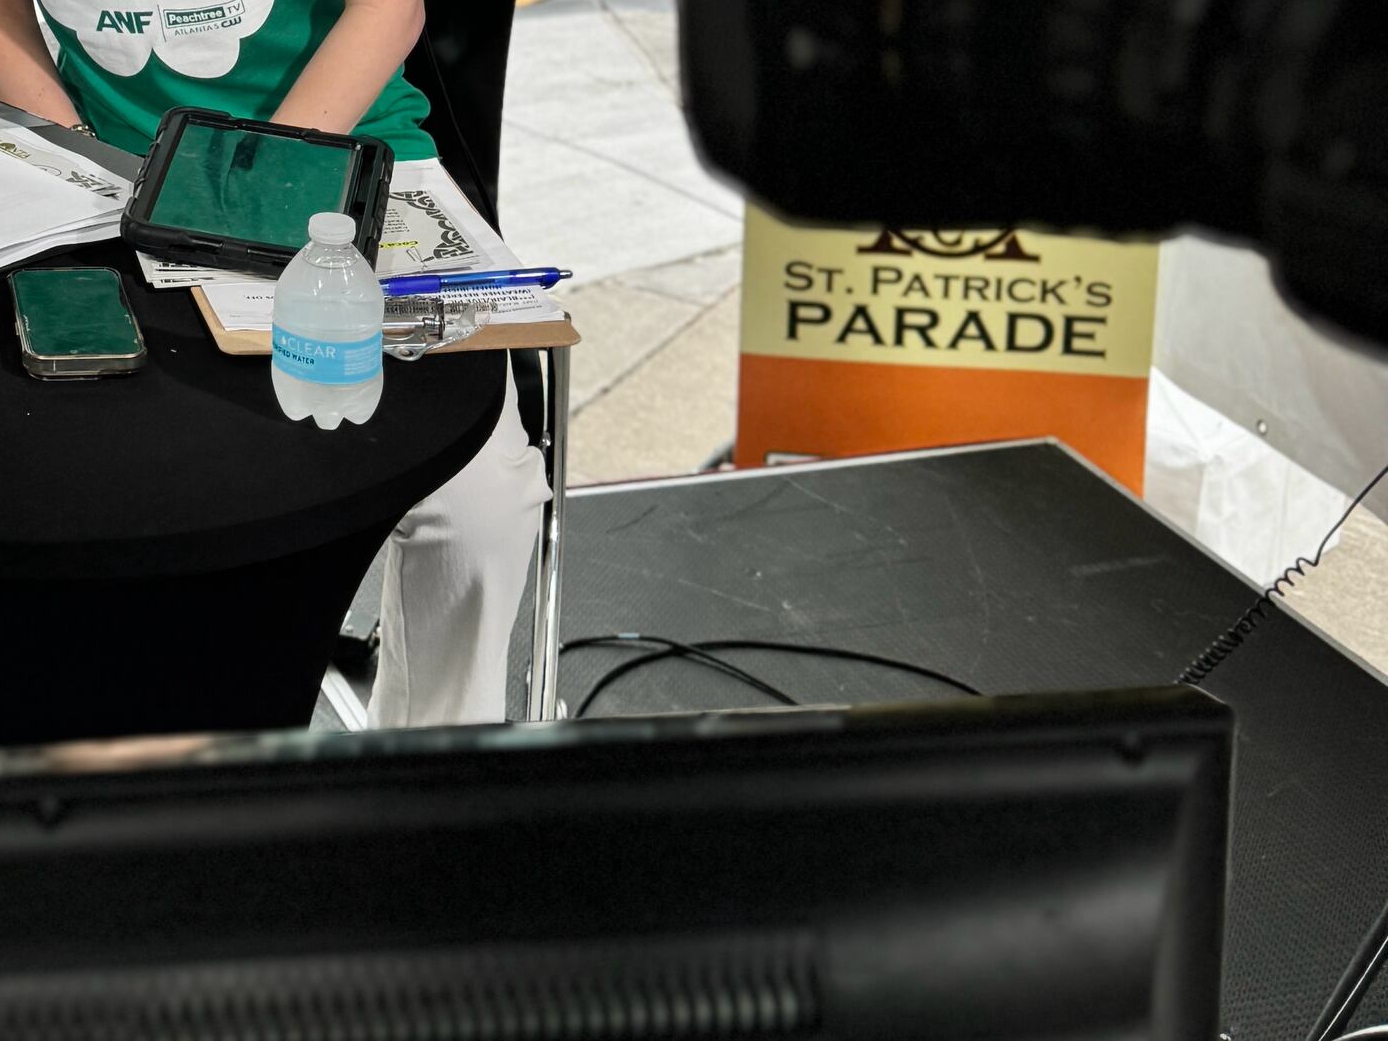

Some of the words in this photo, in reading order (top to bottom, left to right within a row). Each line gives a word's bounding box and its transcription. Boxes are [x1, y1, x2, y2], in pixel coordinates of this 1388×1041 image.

[96, 10, 153, 34] ANF
[168, 9, 223, 25] Peachtree
[227, 3, 240, 14] TV
[221, 16, 242, 28] CW
[871, 264, 1113, 308] PATRICK'S
[784, 299, 1108, 359] PARADE
